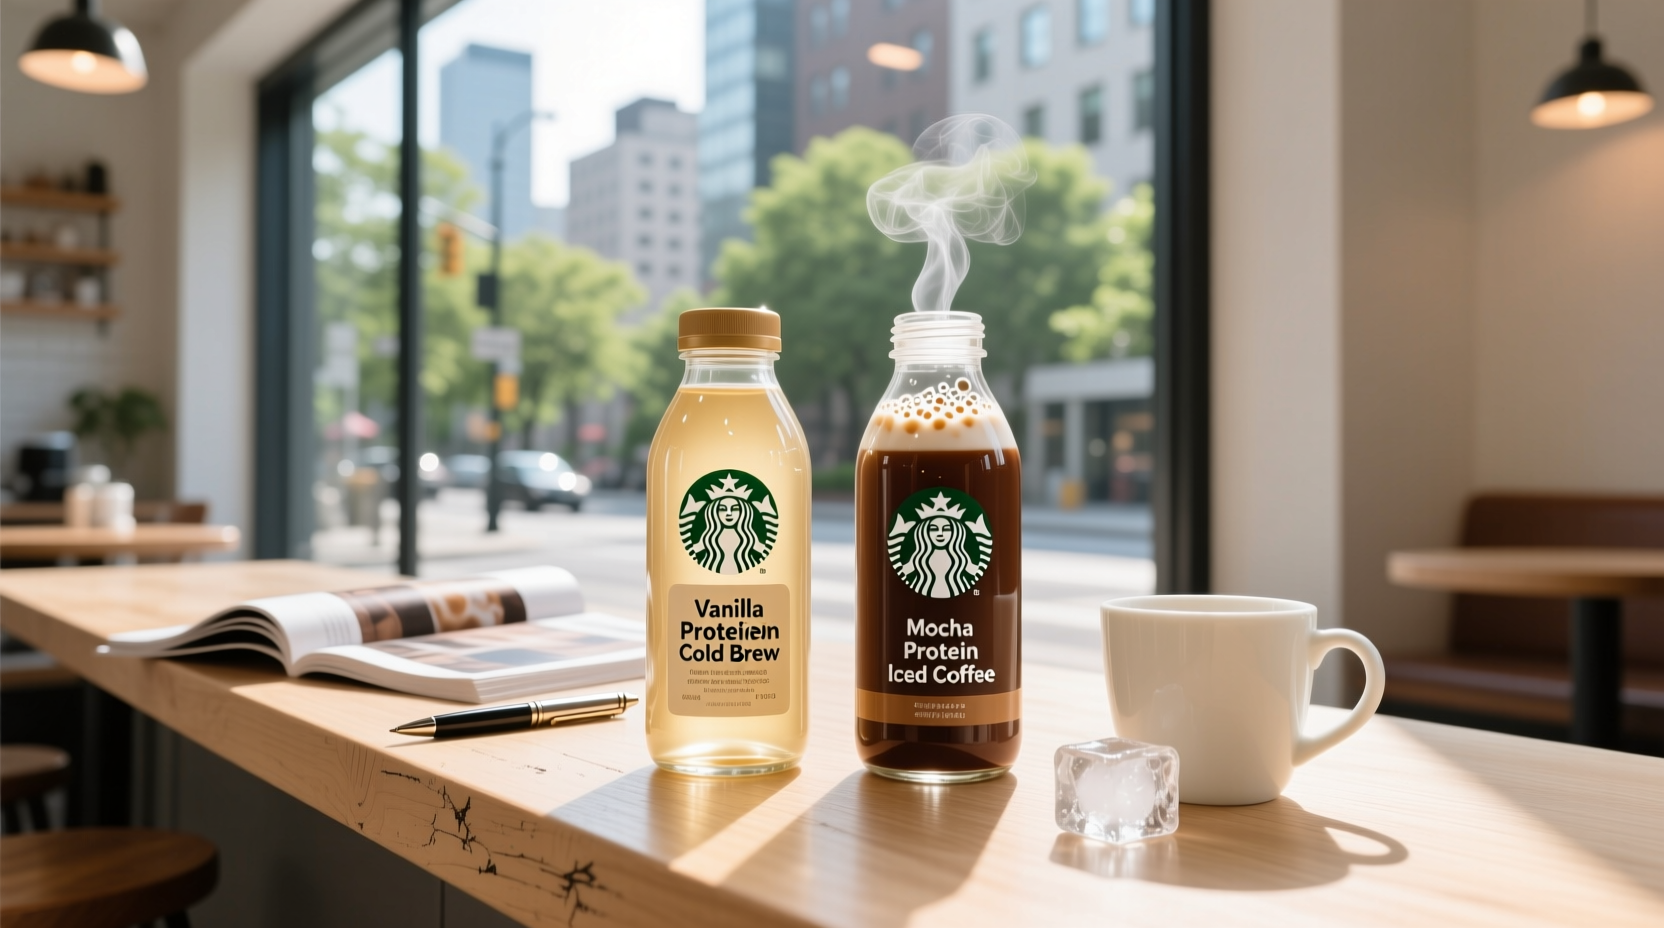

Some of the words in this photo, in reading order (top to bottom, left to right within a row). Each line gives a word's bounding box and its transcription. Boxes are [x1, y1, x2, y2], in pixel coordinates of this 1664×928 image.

[694, 598, 764, 618] Vanilla
[907, 618, 974, 637] Mocha
[679, 643, 724, 662] Cold
[730, 644, 780, 662] Brew
[904, 641, 979, 660] Protein
[888, 664, 928, 684] Iced
[932, 664, 996, 684] Coffee
